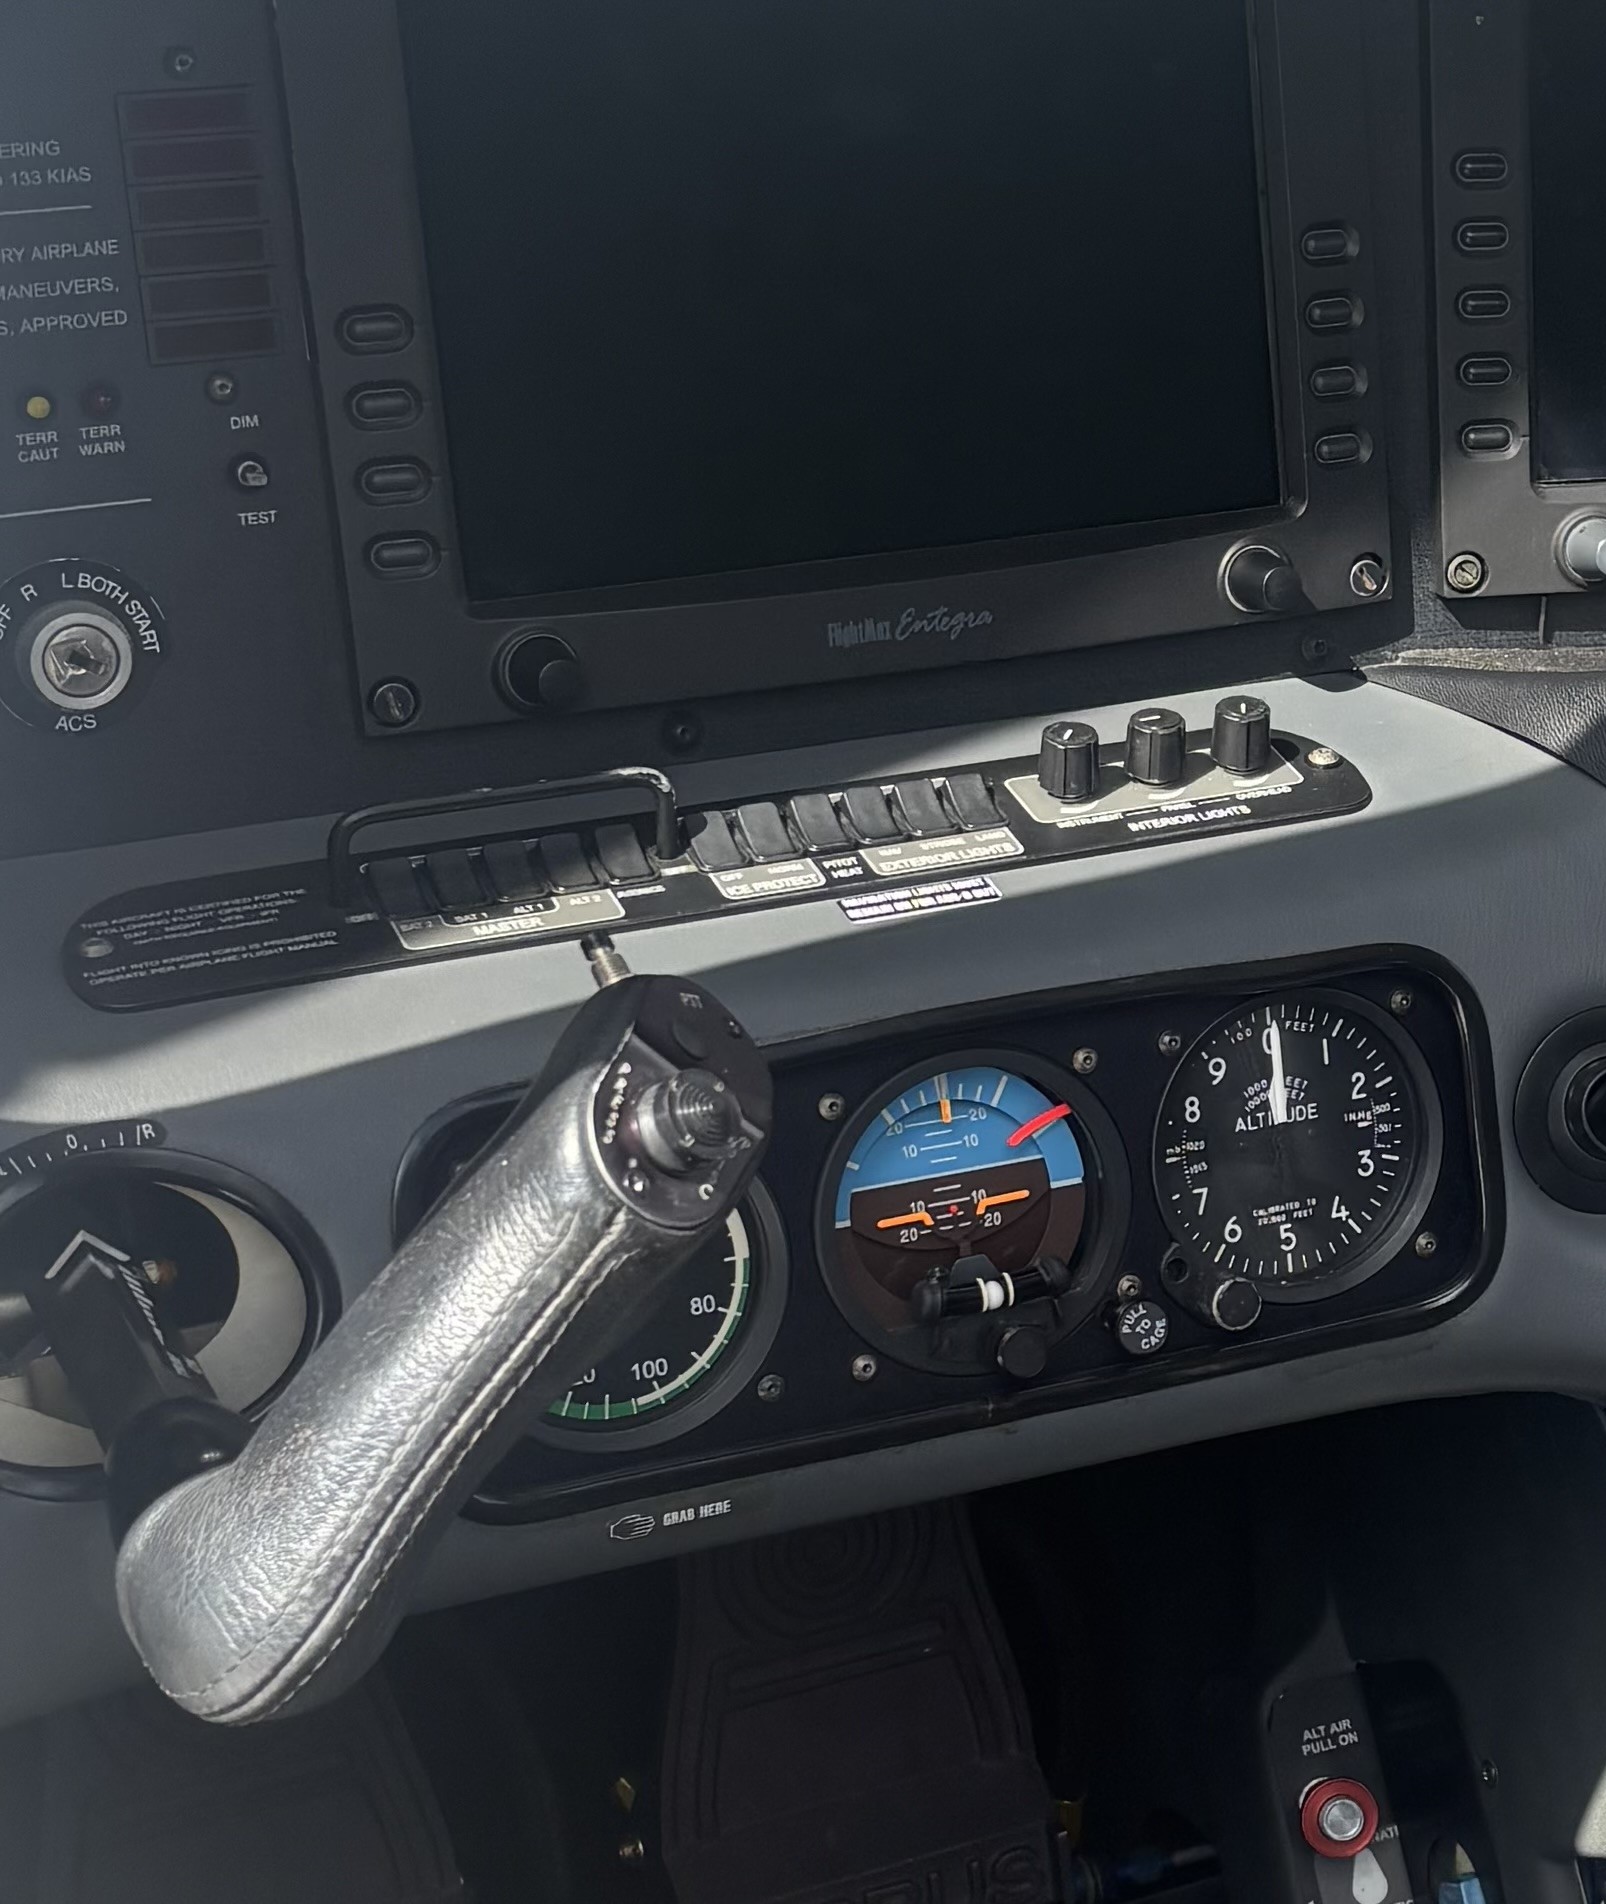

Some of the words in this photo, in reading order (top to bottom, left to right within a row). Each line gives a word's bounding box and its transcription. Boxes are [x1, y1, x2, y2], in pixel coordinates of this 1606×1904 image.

[12, 170, 41, 186] 133
[48, 166, 92, 184] KIAS
[31, 239, 119, 259] AIRPLANE
[21, 310, 128, 334] APPROVED
[80, 424, 121, 440] TERR
[230, 415, 259, 430] DIM
[16, 431, 58, 448] TERR
[79, 440, 126, 457] WARN
[18, 448, 59, 464] CAUT
[237, 510, 278, 527] TEST
[78, 573, 129, 605] BOTH
[895, 606, 993, 641] Entegra
[55, 714, 97, 732] ACS
[1127, 813, 1199, 832] INTERIOR
[1208, 1057, 1227, 1085] 9
[1351, 1072, 1367, 1100] 2
[1184, 1096, 1200, 1123] 8
[1357, 1149, 1375, 1176] 3
[1192, 1187, 1208, 1215] 7
[1223, 1216, 1243, 1243] 6
[1279, 1224, 1296, 1251] 5
[689, 1294, 716, 1316] 80
[631, 1357, 669, 1381] 100
[1302, 1724, 1329, 1743] ALT
[1330, 1718, 1352, 1736] AIR
[1301, 1736, 1336, 1756] PULL
[1338, 1730, 1358, 1748] ON
